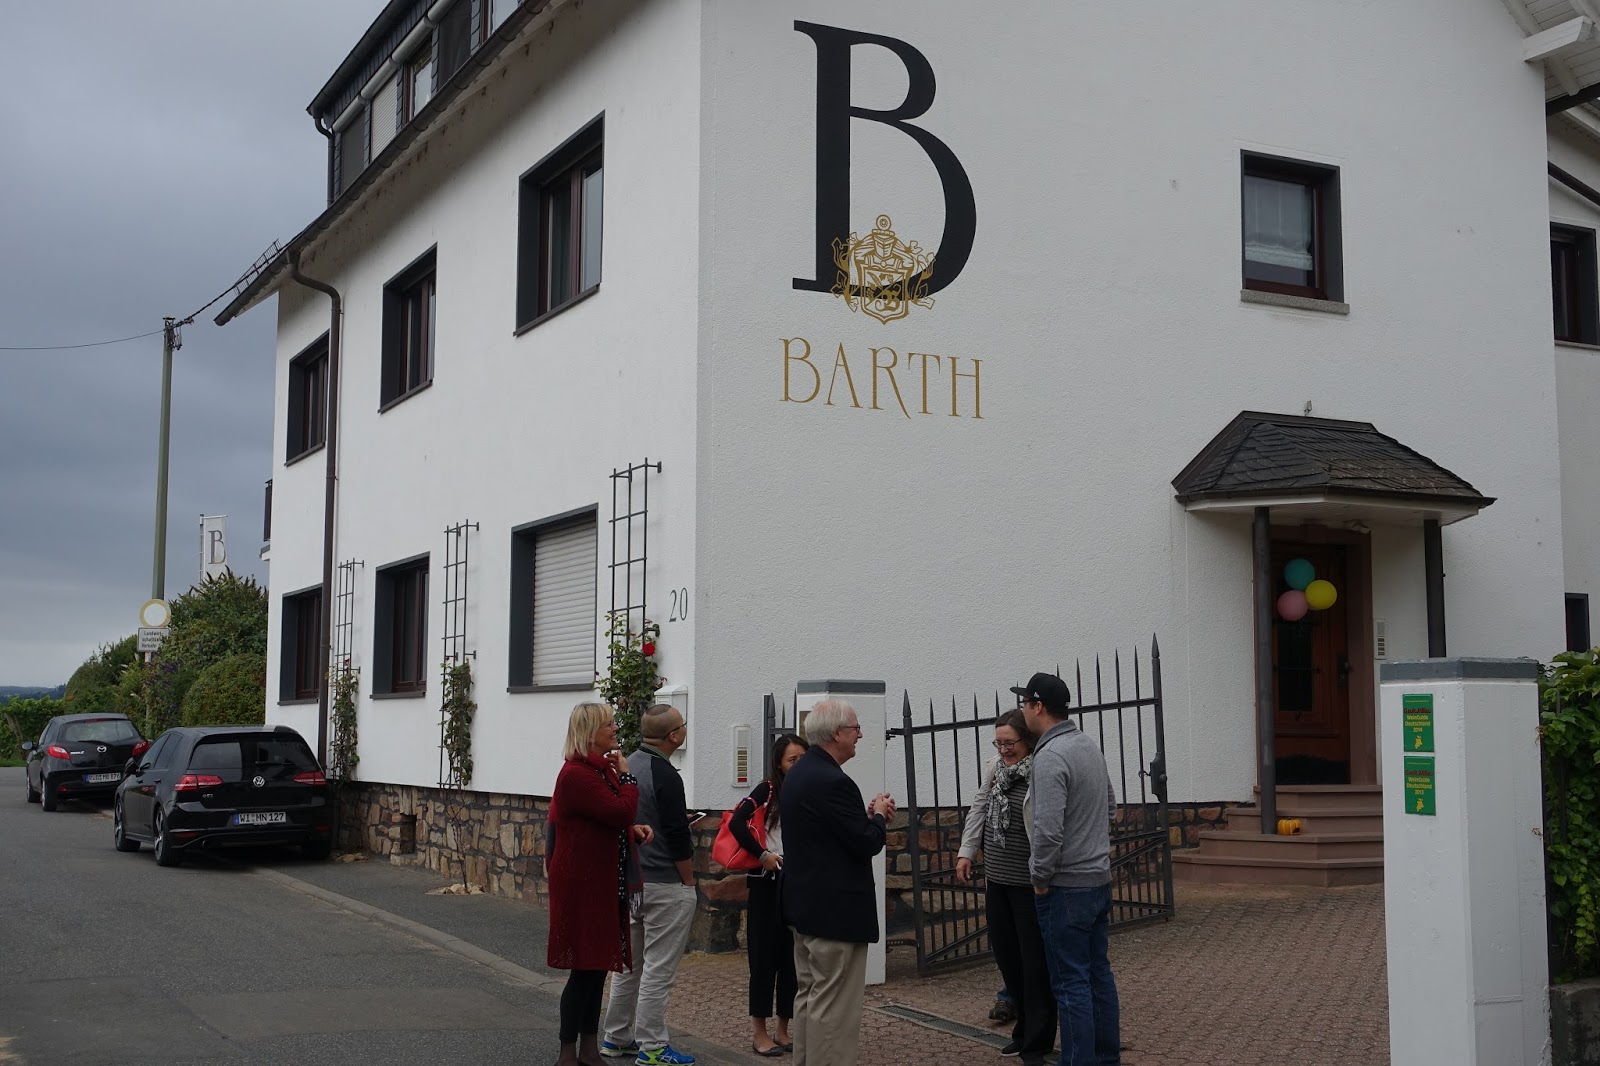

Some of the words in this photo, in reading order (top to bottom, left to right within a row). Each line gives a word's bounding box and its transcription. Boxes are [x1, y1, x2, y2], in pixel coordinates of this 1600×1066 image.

[792, 20, 977, 298] B
[779, 336, 985, 420] BARTH
[208, 529, 227, 565] B
[669, 587, 688, 622] 20
[269, 812, 284, 822] 127
